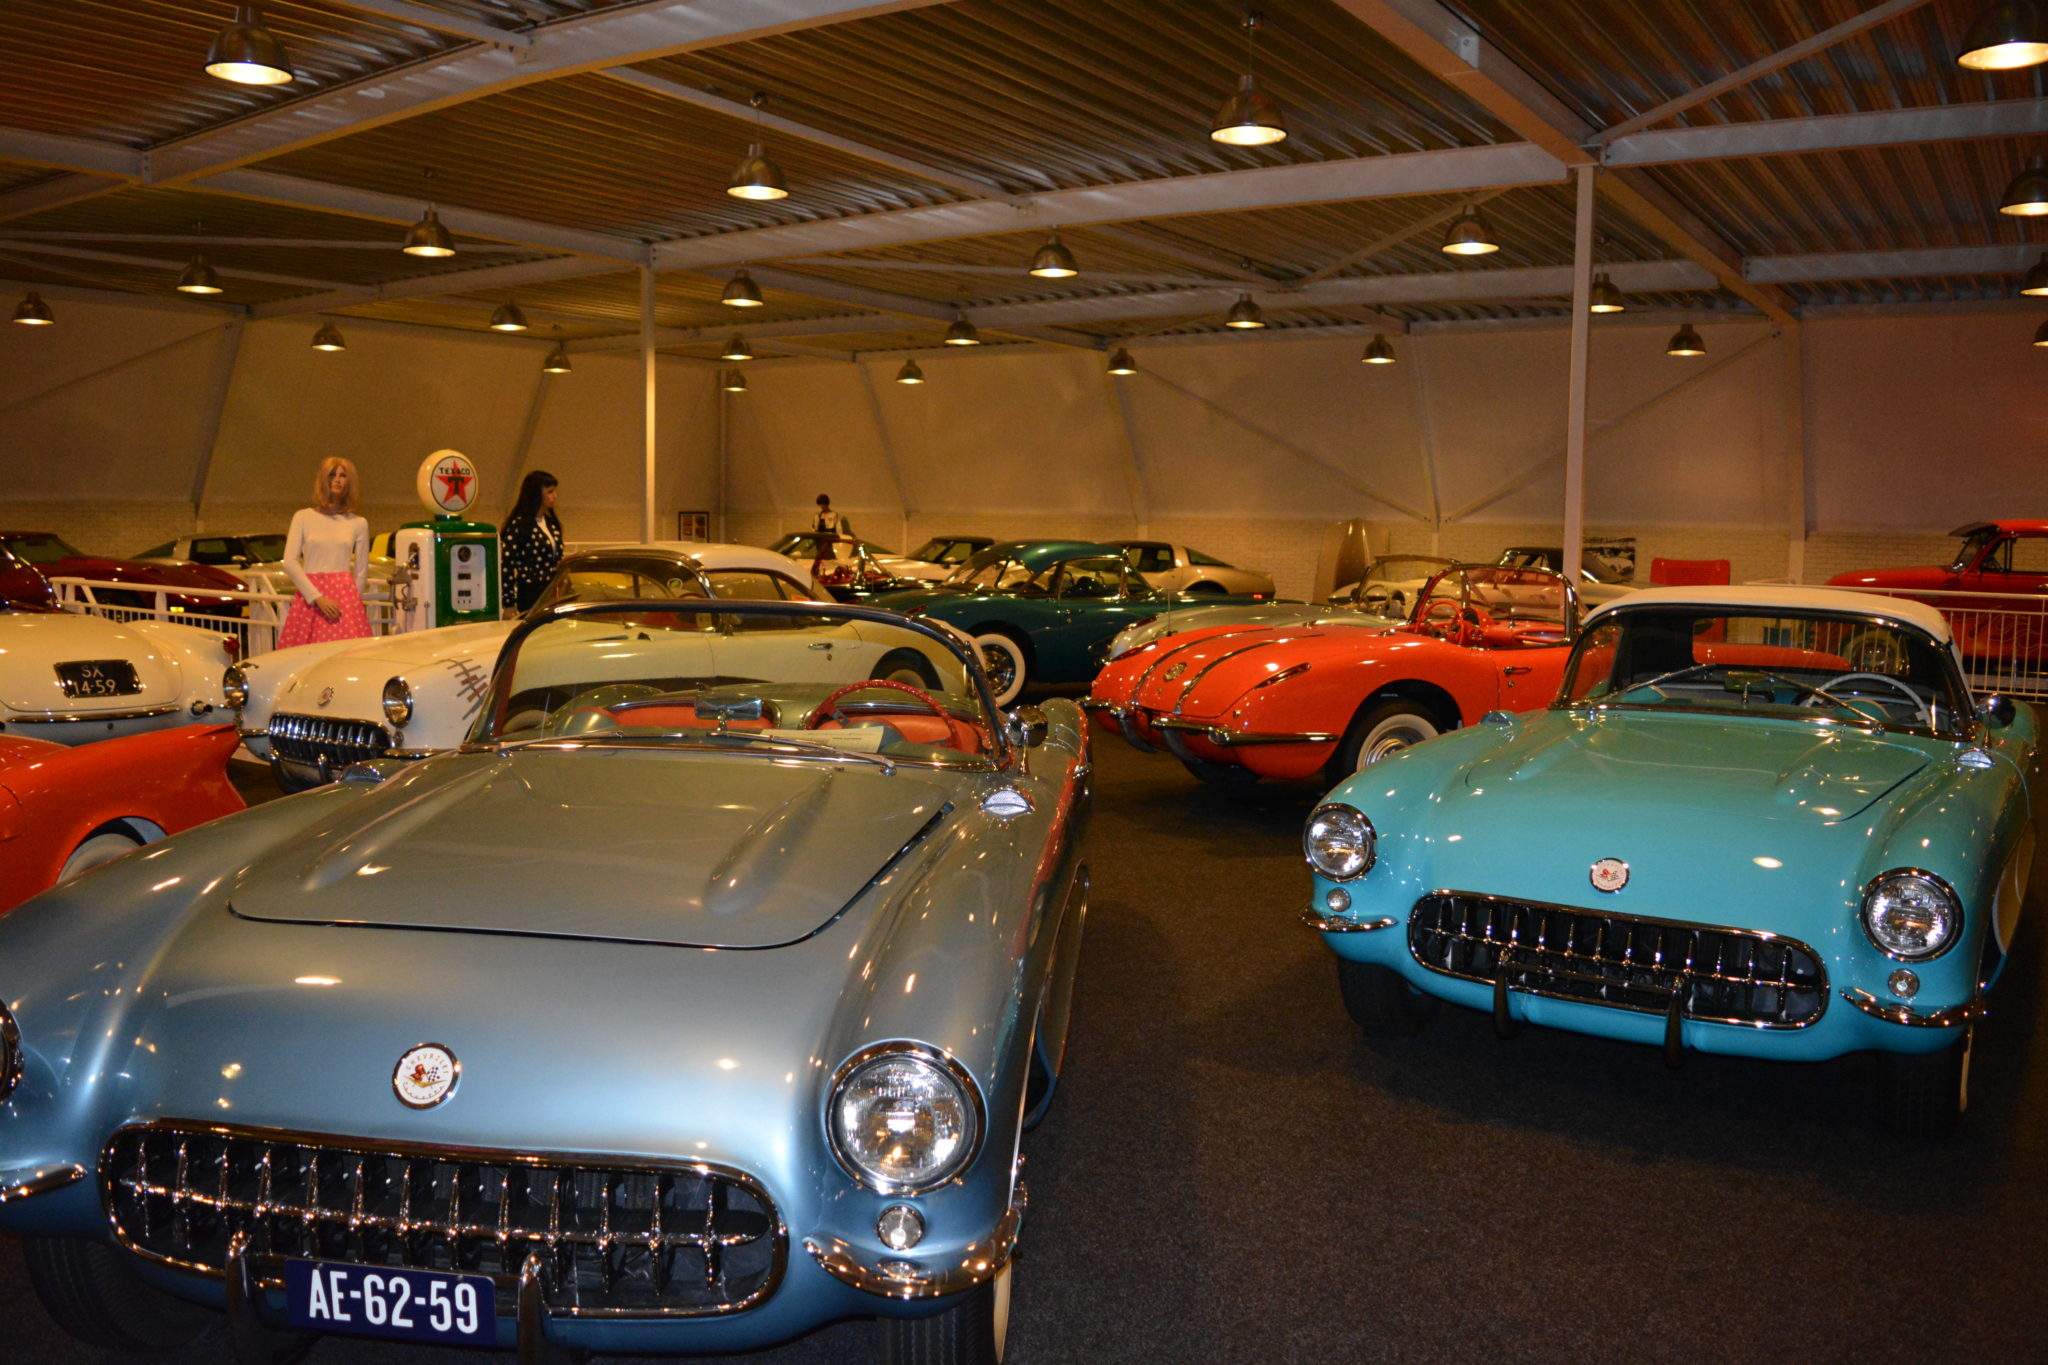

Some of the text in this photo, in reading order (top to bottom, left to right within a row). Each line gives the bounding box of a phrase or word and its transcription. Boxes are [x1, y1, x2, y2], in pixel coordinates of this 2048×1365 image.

[438, 466, 471, 476] TEXACO
[447, 476, 465, 496] T
[81, 664, 104, 678] SX
[309, 1269, 479, 1334] AE-62-59
